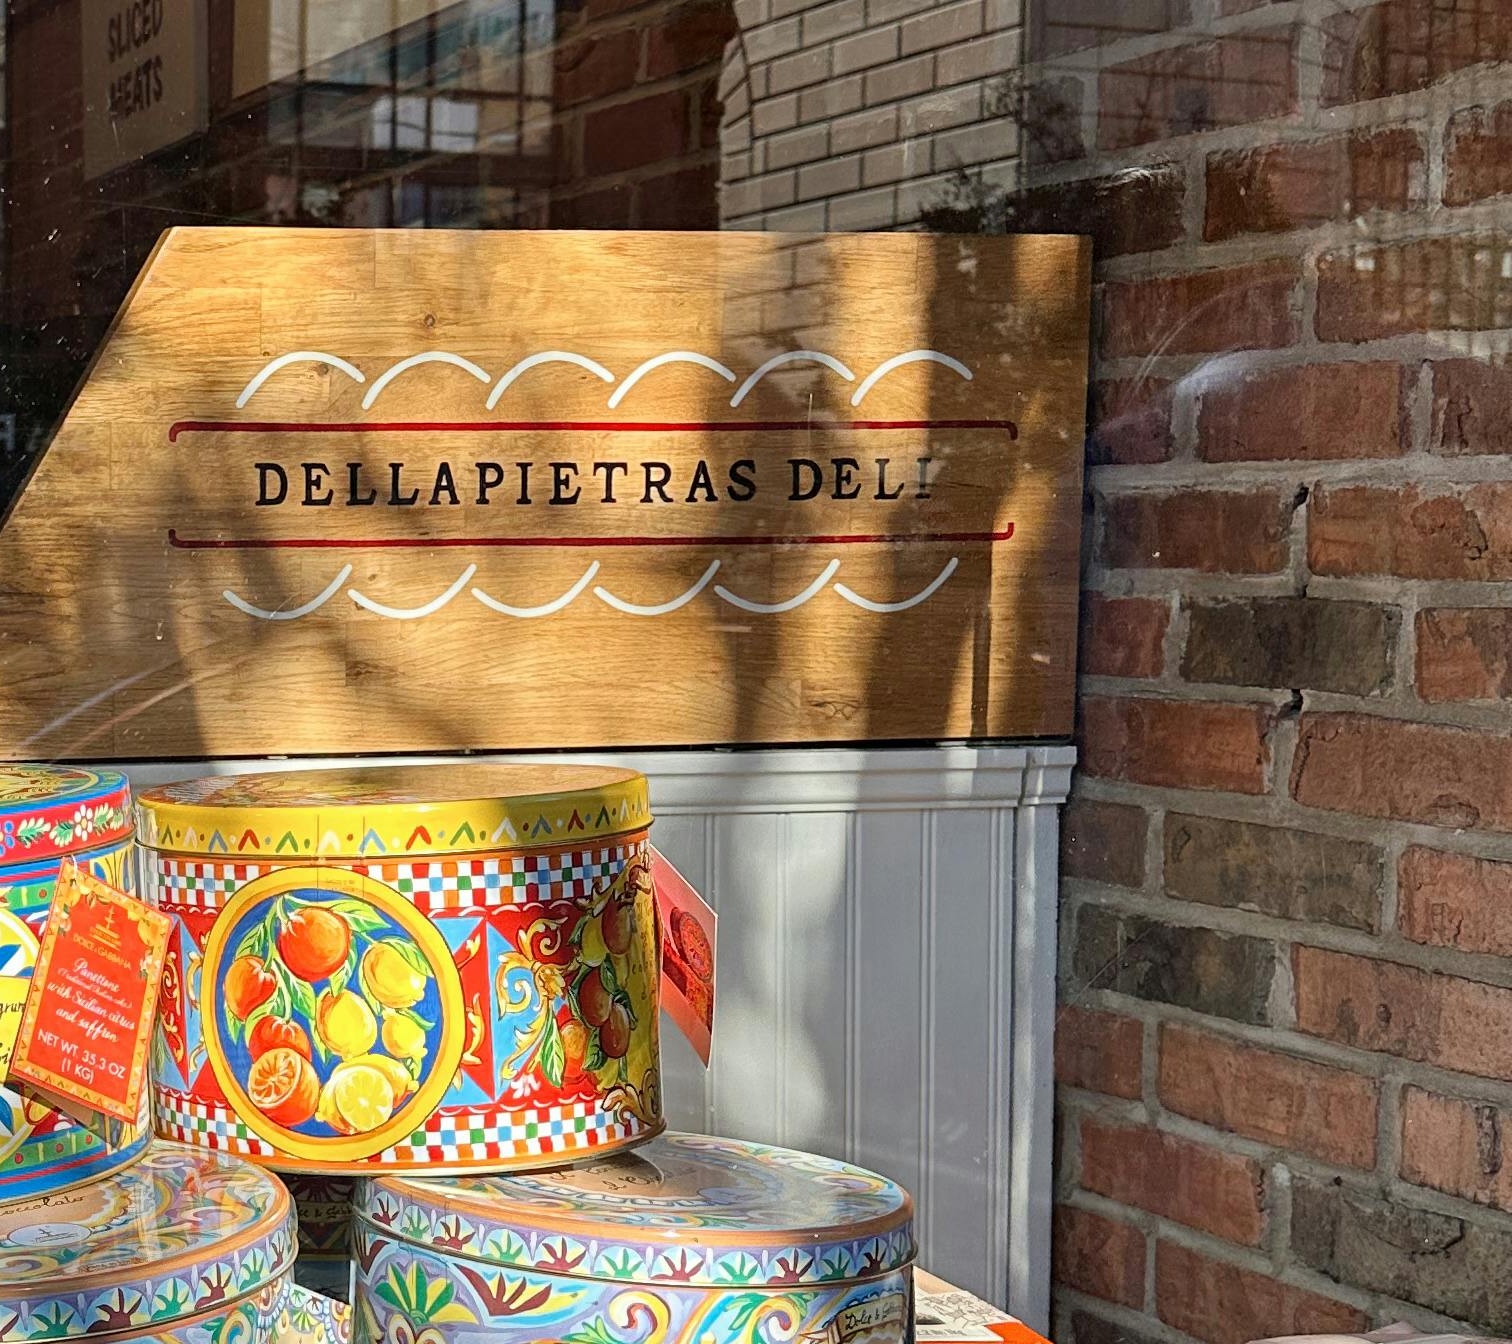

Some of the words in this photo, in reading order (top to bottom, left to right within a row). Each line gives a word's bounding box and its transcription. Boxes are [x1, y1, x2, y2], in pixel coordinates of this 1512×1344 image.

[254, 458, 757, 508] DELLAPIETRAS
[787, 456, 933, 503] DELI
[74, 957, 120, 993] Panettone
[47, 981, 71, 1000] with
[73, 990, 109, 1018] Sicilian
[108, 1008, 136, 1031] citrus
[55, 1007, 80, 1026] and
[79, 1014, 118, 1044] saffron
[37, 1029, 59, 1046] NET
[82, 1049, 107, 1071] 35.3
[108, 1062, 127, 1080] OZ
[74, 1063, 95, 1086] KG)
